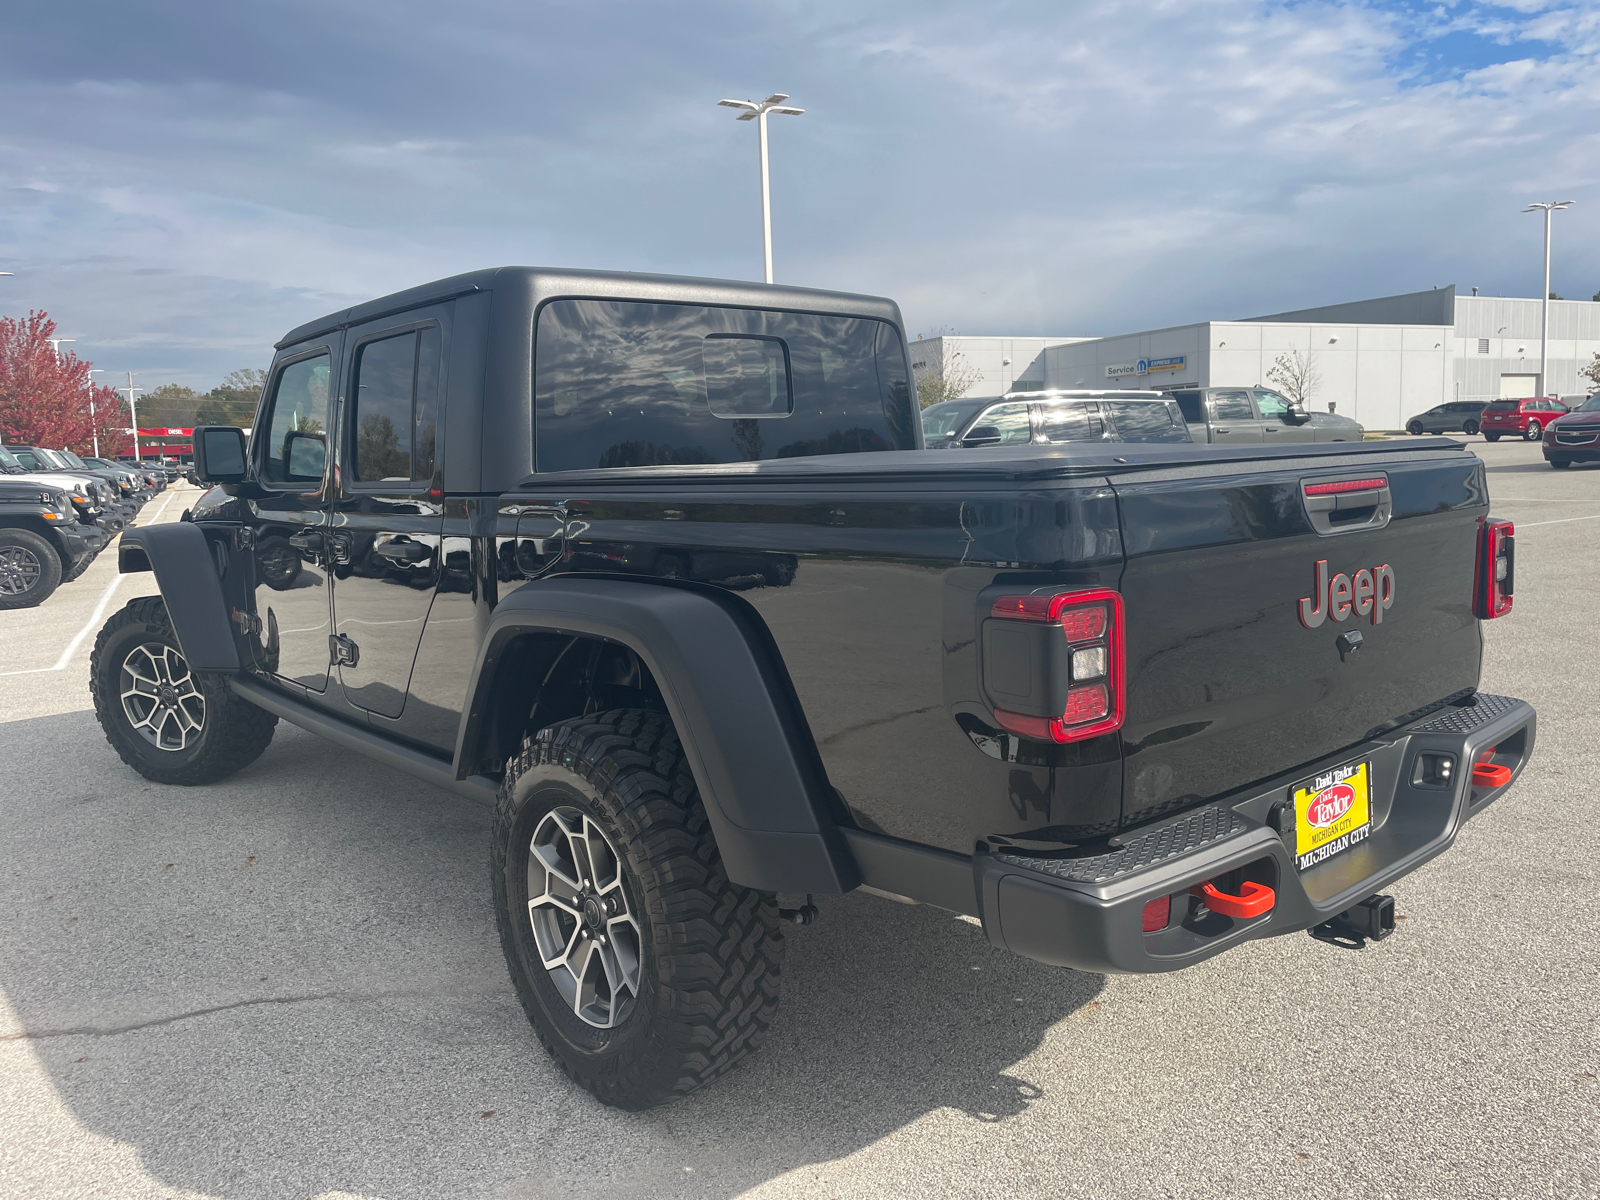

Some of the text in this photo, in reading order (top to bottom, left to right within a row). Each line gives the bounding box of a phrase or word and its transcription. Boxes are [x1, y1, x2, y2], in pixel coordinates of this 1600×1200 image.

[1107, 365, 1134, 375] Service
[1300, 559, 1396, 629] Jeep
[1315, 766, 1353, 791] David Taylor
[1313, 794, 1351, 824] Taylor
[1319, 788, 1334, 804] David
[1311, 817, 1353, 845] MICHIGAN CITY
[1299, 823, 1371, 870] MICHIGAN CITY
